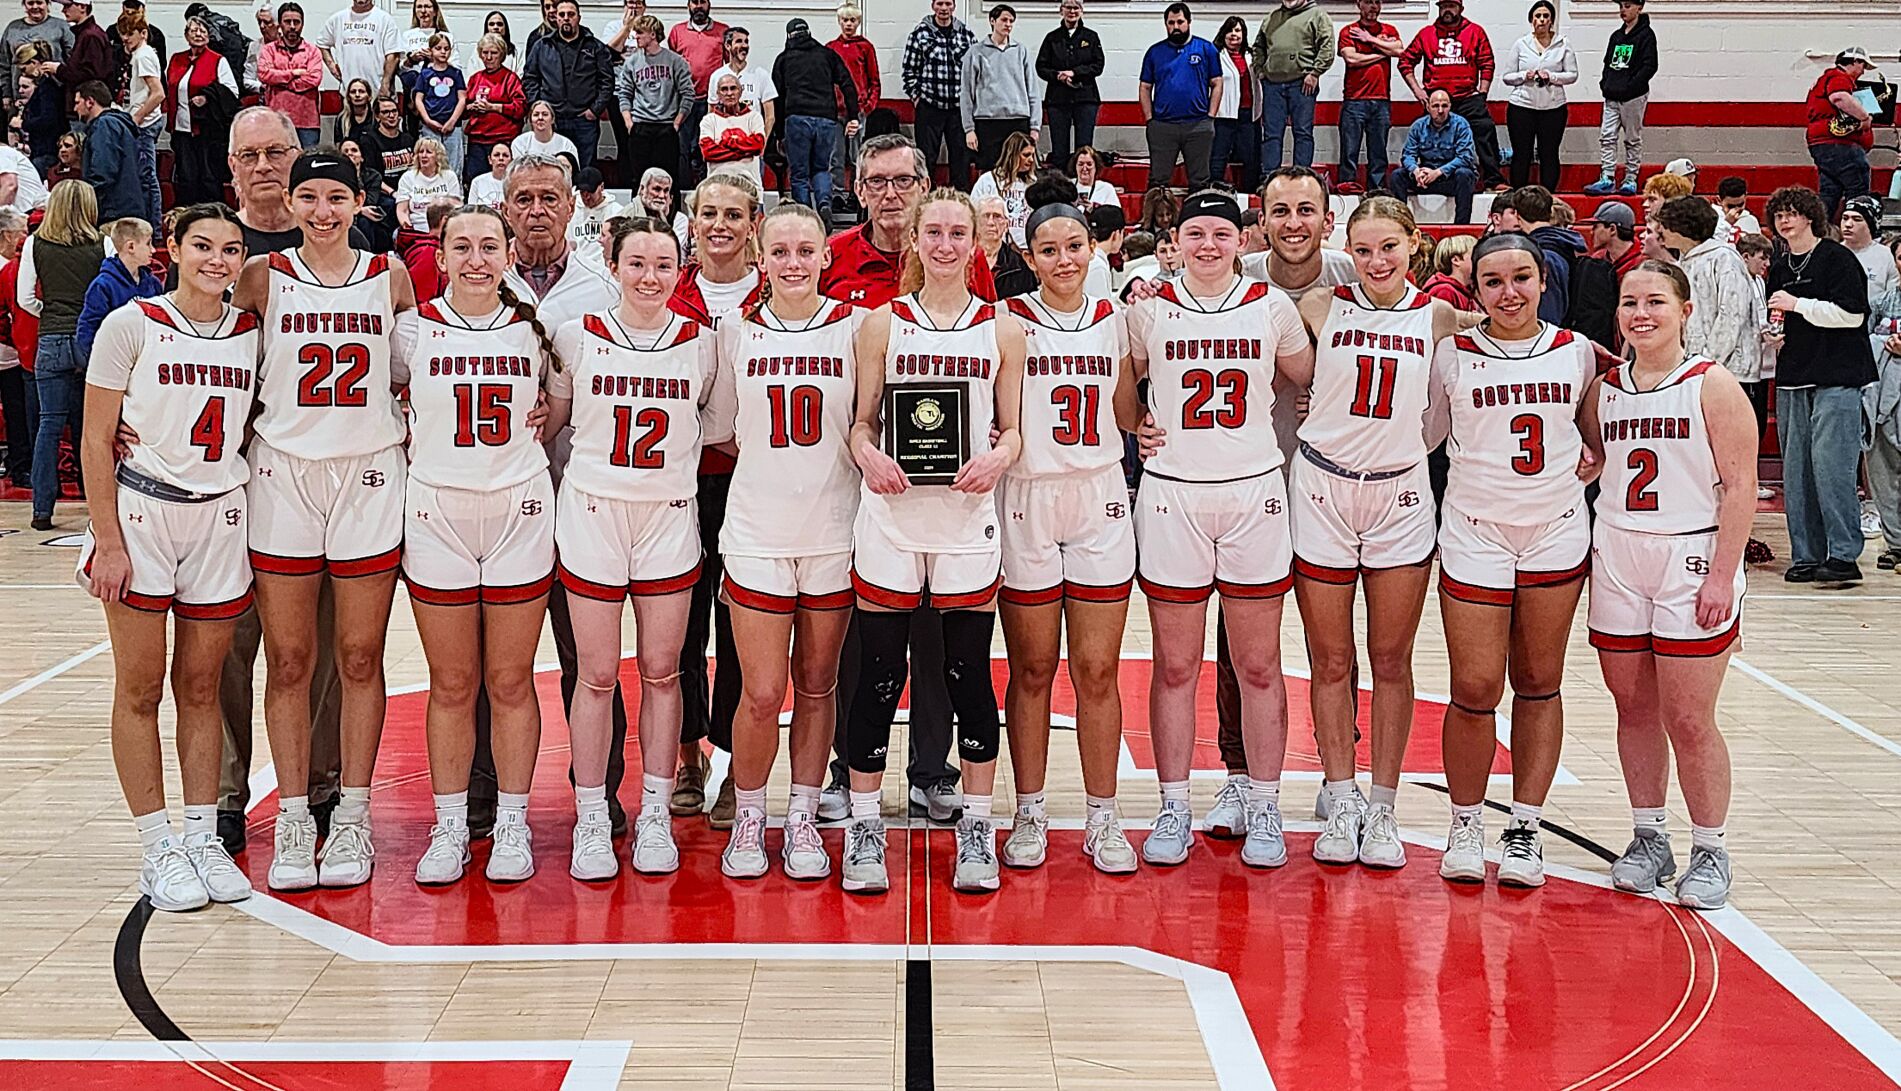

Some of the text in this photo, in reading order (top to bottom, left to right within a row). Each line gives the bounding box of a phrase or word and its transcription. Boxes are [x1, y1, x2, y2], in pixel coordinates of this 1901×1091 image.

[635, 64, 671, 82] FLORIDA
[1433, 57, 1468, 65] BASEBALL
[281, 313, 382, 335] SOUTHERN
[1166, 339, 1260, 360] SOUTHERN
[1332, 330, 1424, 358] SOUTHERN
[298, 343, 370, 407] 22
[430, 356, 531, 377] SOUTHERN
[748, 357, 842, 378] SOUTHERN
[896, 354, 990, 380] SOUTHERN
[592, 375, 689, 400] SOUTHERN
[1182, 369, 1248, 429] 23
[1350, 355, 1398, 419] 11
[453, 384, 512, 447] 15
[767, 385, 823, 448] 10
[1051, 385, 1100, 446] 31
[190, 396, 225, 462] 4
[610, 405, 669, 469] 12
[1510, 413, 1545, 476] 3
[362, 470, 384, 487] SG
[1626, 448, 1658, 511] 2
[522, 500, 541, 515] SG
[1106, 502, 1125, 519] SG
[1265, 498, 1281, 515] SG
[1686, 557, 1710, 575] SG
